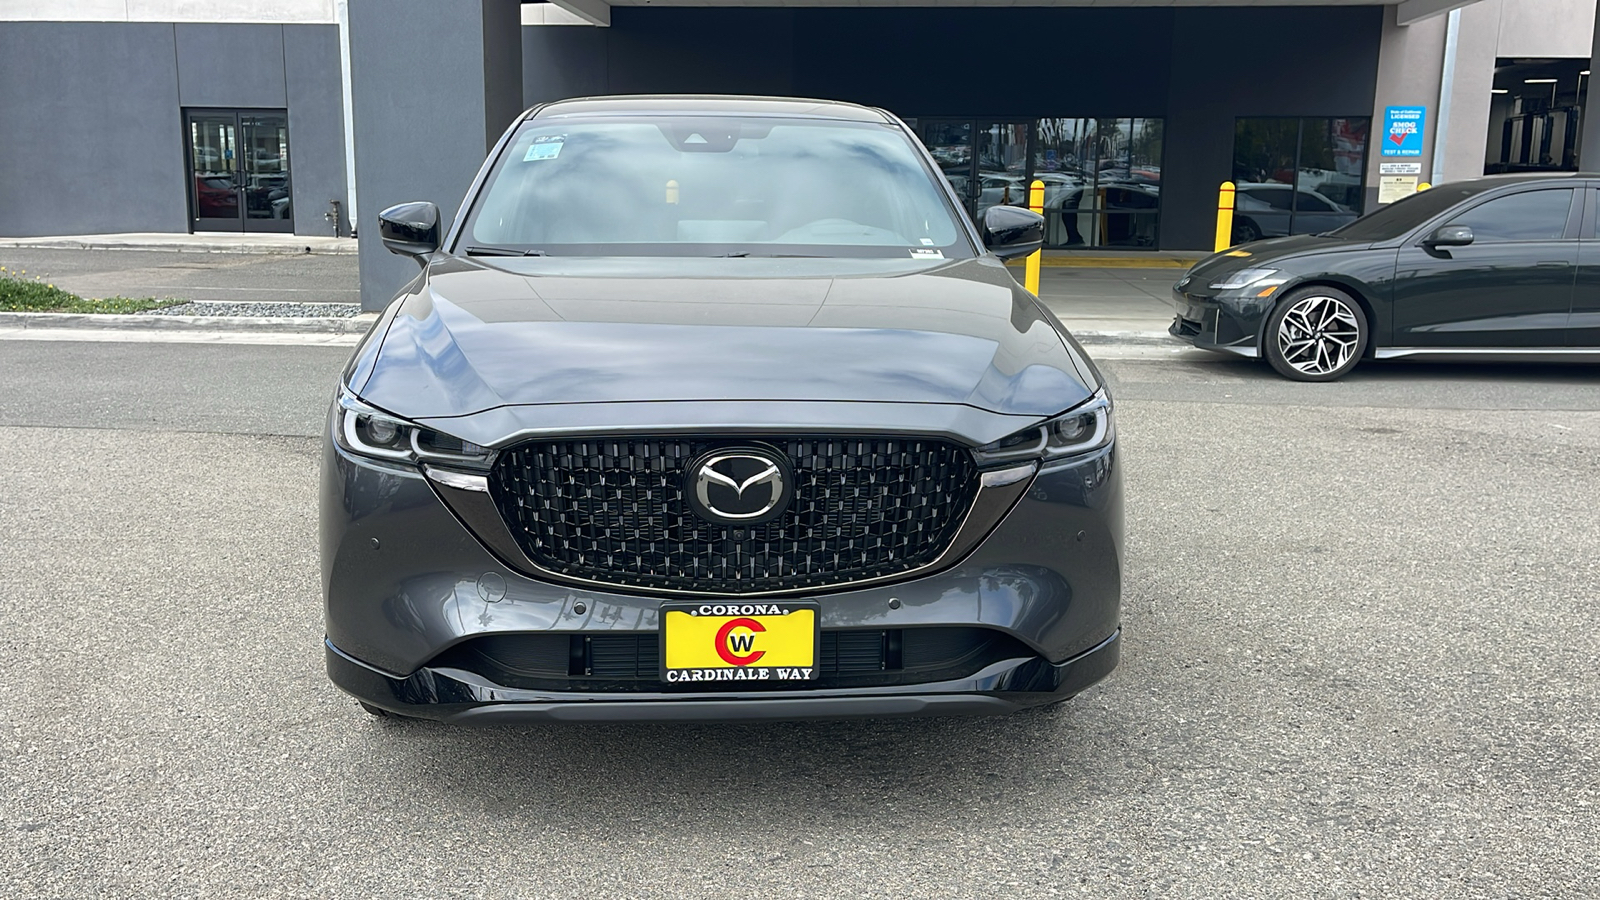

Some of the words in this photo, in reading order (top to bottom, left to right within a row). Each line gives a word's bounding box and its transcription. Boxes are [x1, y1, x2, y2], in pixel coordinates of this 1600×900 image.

[699, 604, 782, 616] CORONA
[666, 668, 770, 682] CARDINALE
[776, 668, 813, 680] WAY
